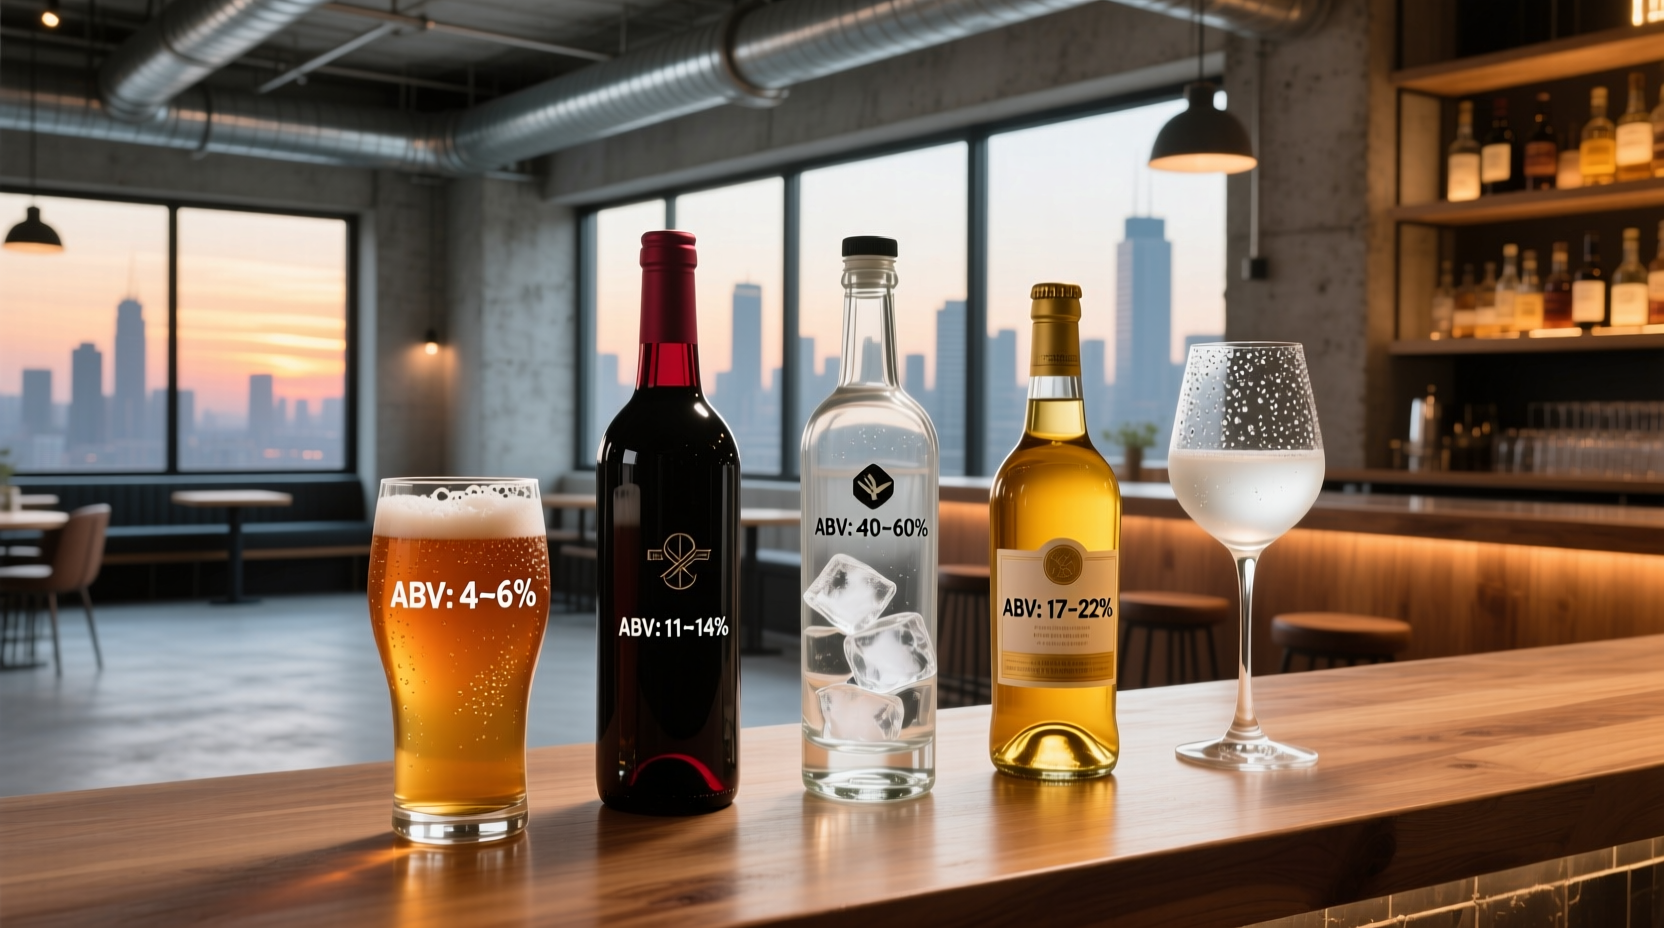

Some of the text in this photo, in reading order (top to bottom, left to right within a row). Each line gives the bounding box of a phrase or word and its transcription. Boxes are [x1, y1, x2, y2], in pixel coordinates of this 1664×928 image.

[814, 517, 853, 537] ABV:
[390, 580, 454, 609] ABV:
[1002, 597, 1042, 619] ABV:
[618, 616, 661, 637] ABV:
